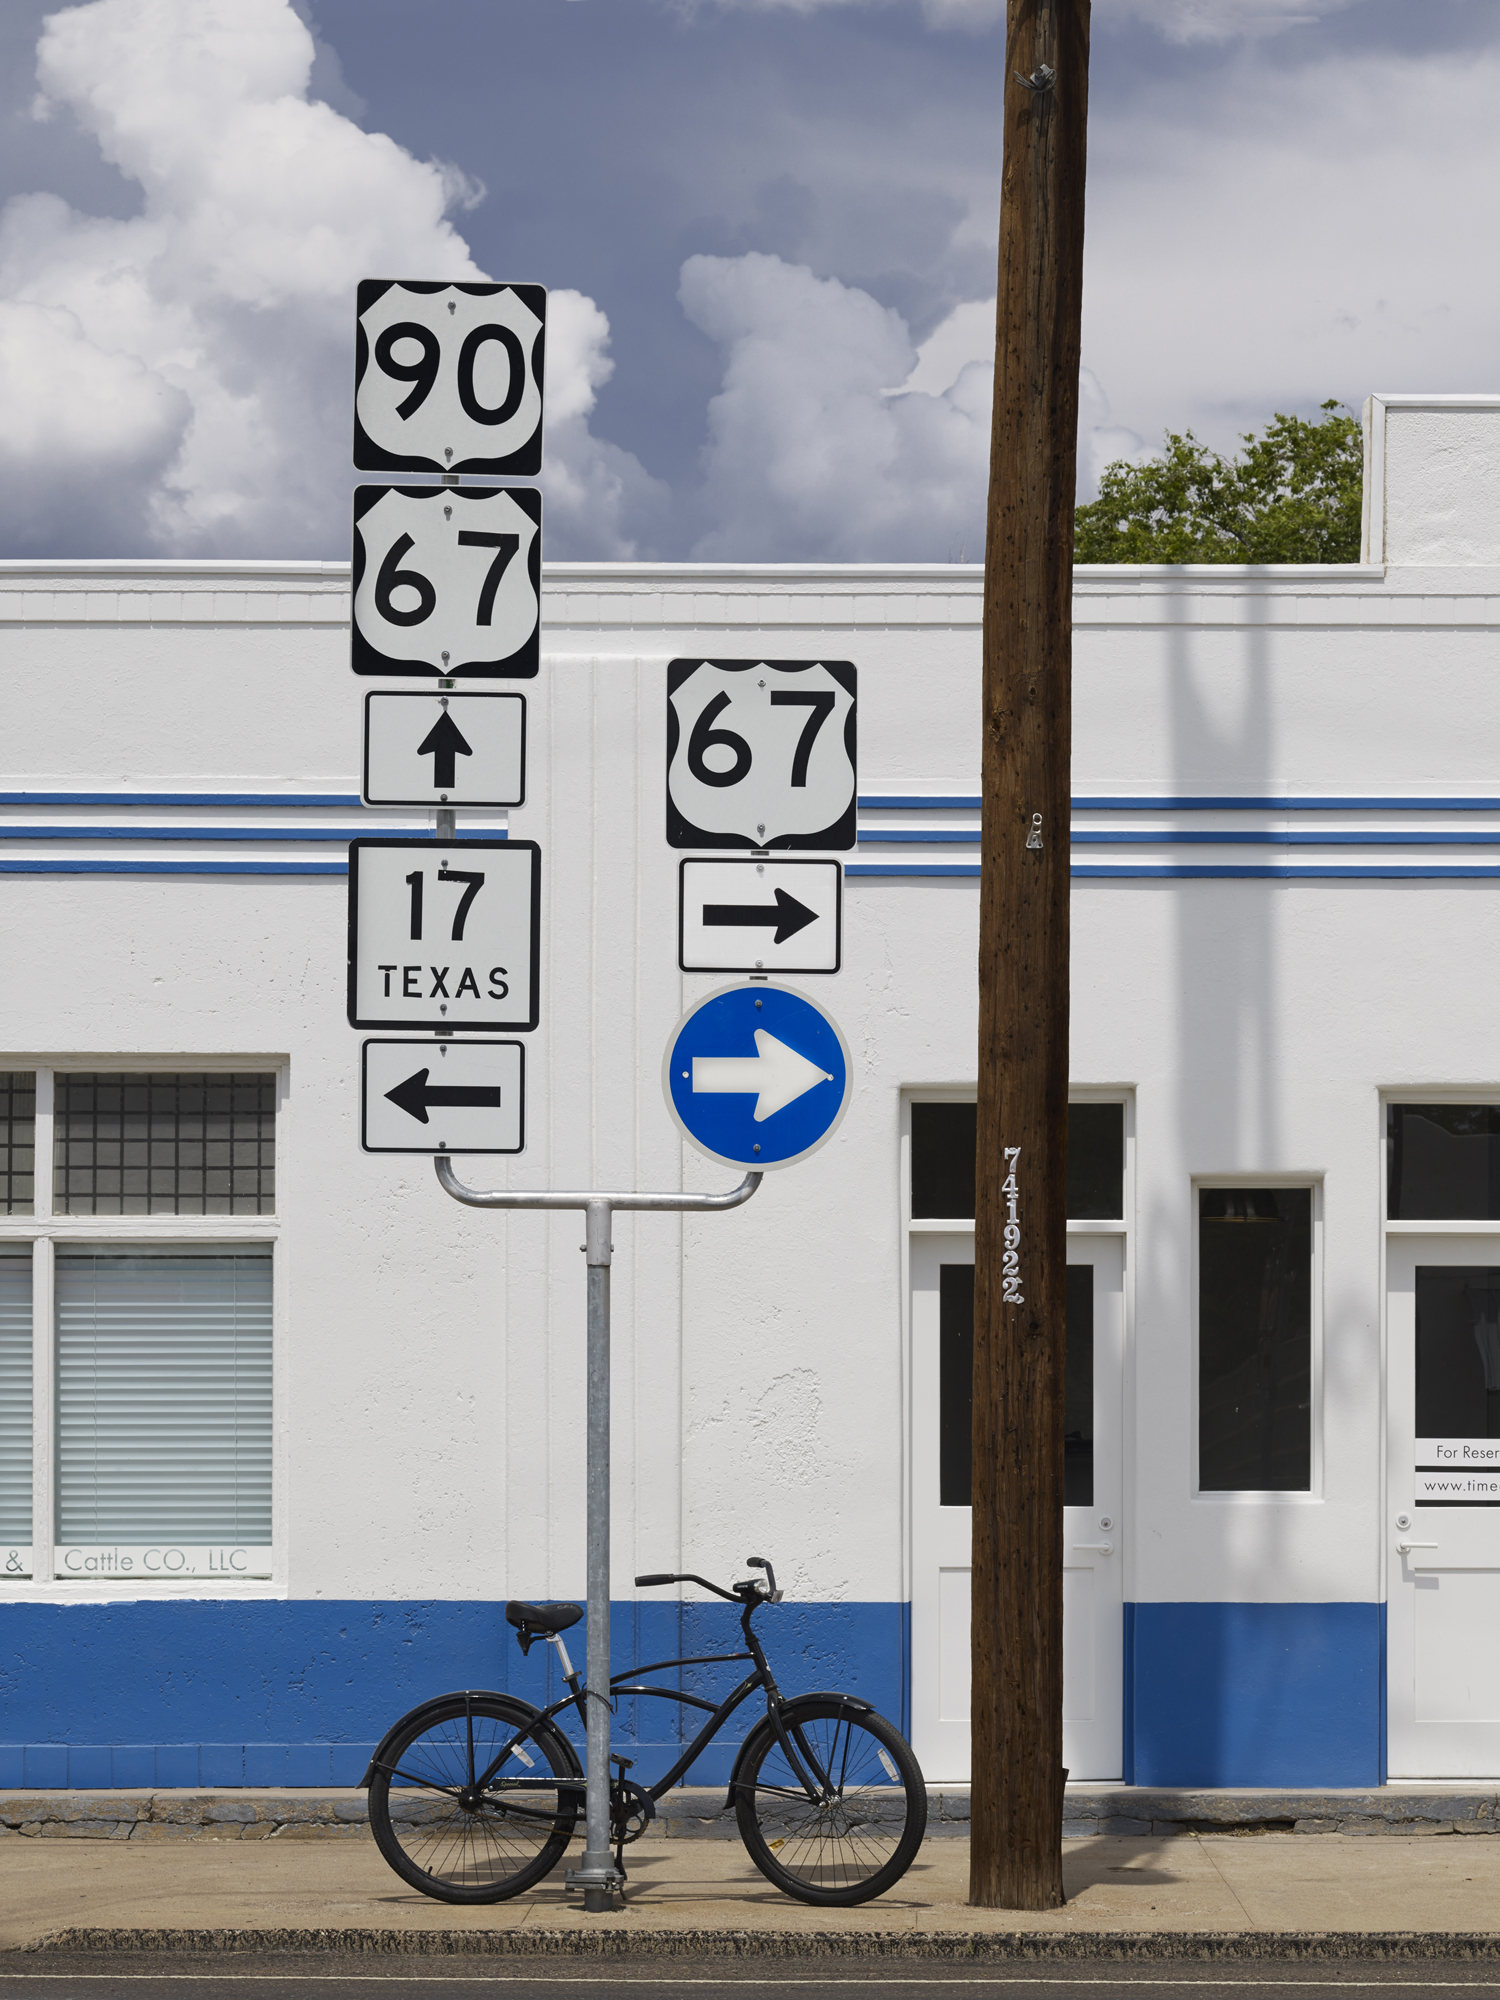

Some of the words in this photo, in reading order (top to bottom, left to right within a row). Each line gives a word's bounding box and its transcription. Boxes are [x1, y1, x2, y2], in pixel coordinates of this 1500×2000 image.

[374, 321, 526, 426] 90
[374, 530, 520, 628] 67
[687, 690, 836, 788] 67
[405, 869, 485, 942] 17
[377, 964, 509, 1000] TEXAS
[1001, 1146, 1025, 1305] 741922
[1424, 1479, 1500, 1492] www.time
[1436, 1445, 1458, 1459] For
[1463, 1445, 1500, 1459] Reser
[5, 1549, 24, 1572] &
[64, 1547, 134, 1572] Cattle
[143, 1548, 196, 1574] CO.,
[208, 1548, 248, 1572] LLC
